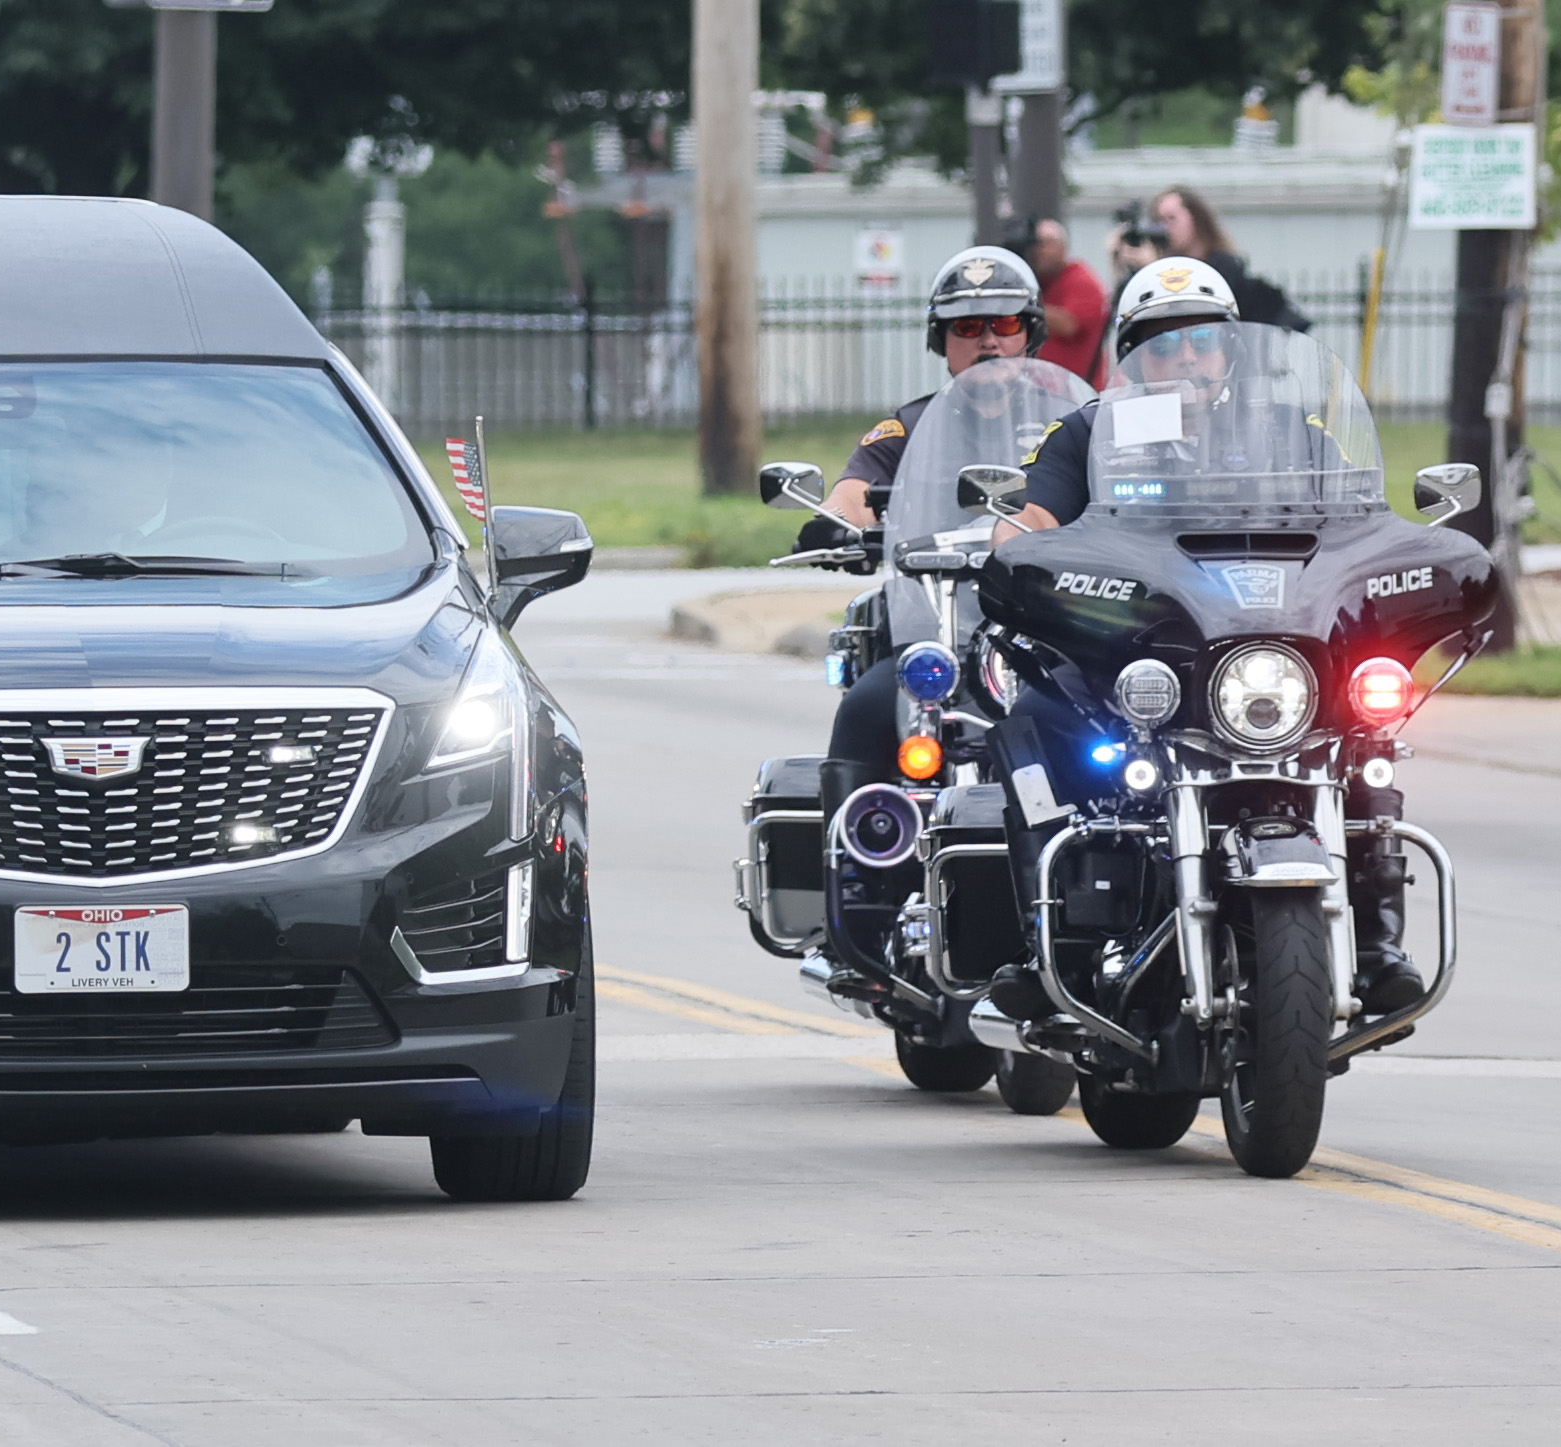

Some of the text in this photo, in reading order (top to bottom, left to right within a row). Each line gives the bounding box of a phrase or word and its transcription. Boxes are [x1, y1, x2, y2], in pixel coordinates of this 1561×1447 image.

[1230, 569, 1278, 580] PARMA
[1054, 571, 1137, 601] POLICE
[1367, 566, 1433, 599] POLICE
[1245, 596, 1277, 604] POLICE
[81, 909, 123, 922] OHIO
[56, 932, 71, 972] 2
[95, 931, 151, 972] STK
[72, 977, 133, 987] LIVERY VEH
